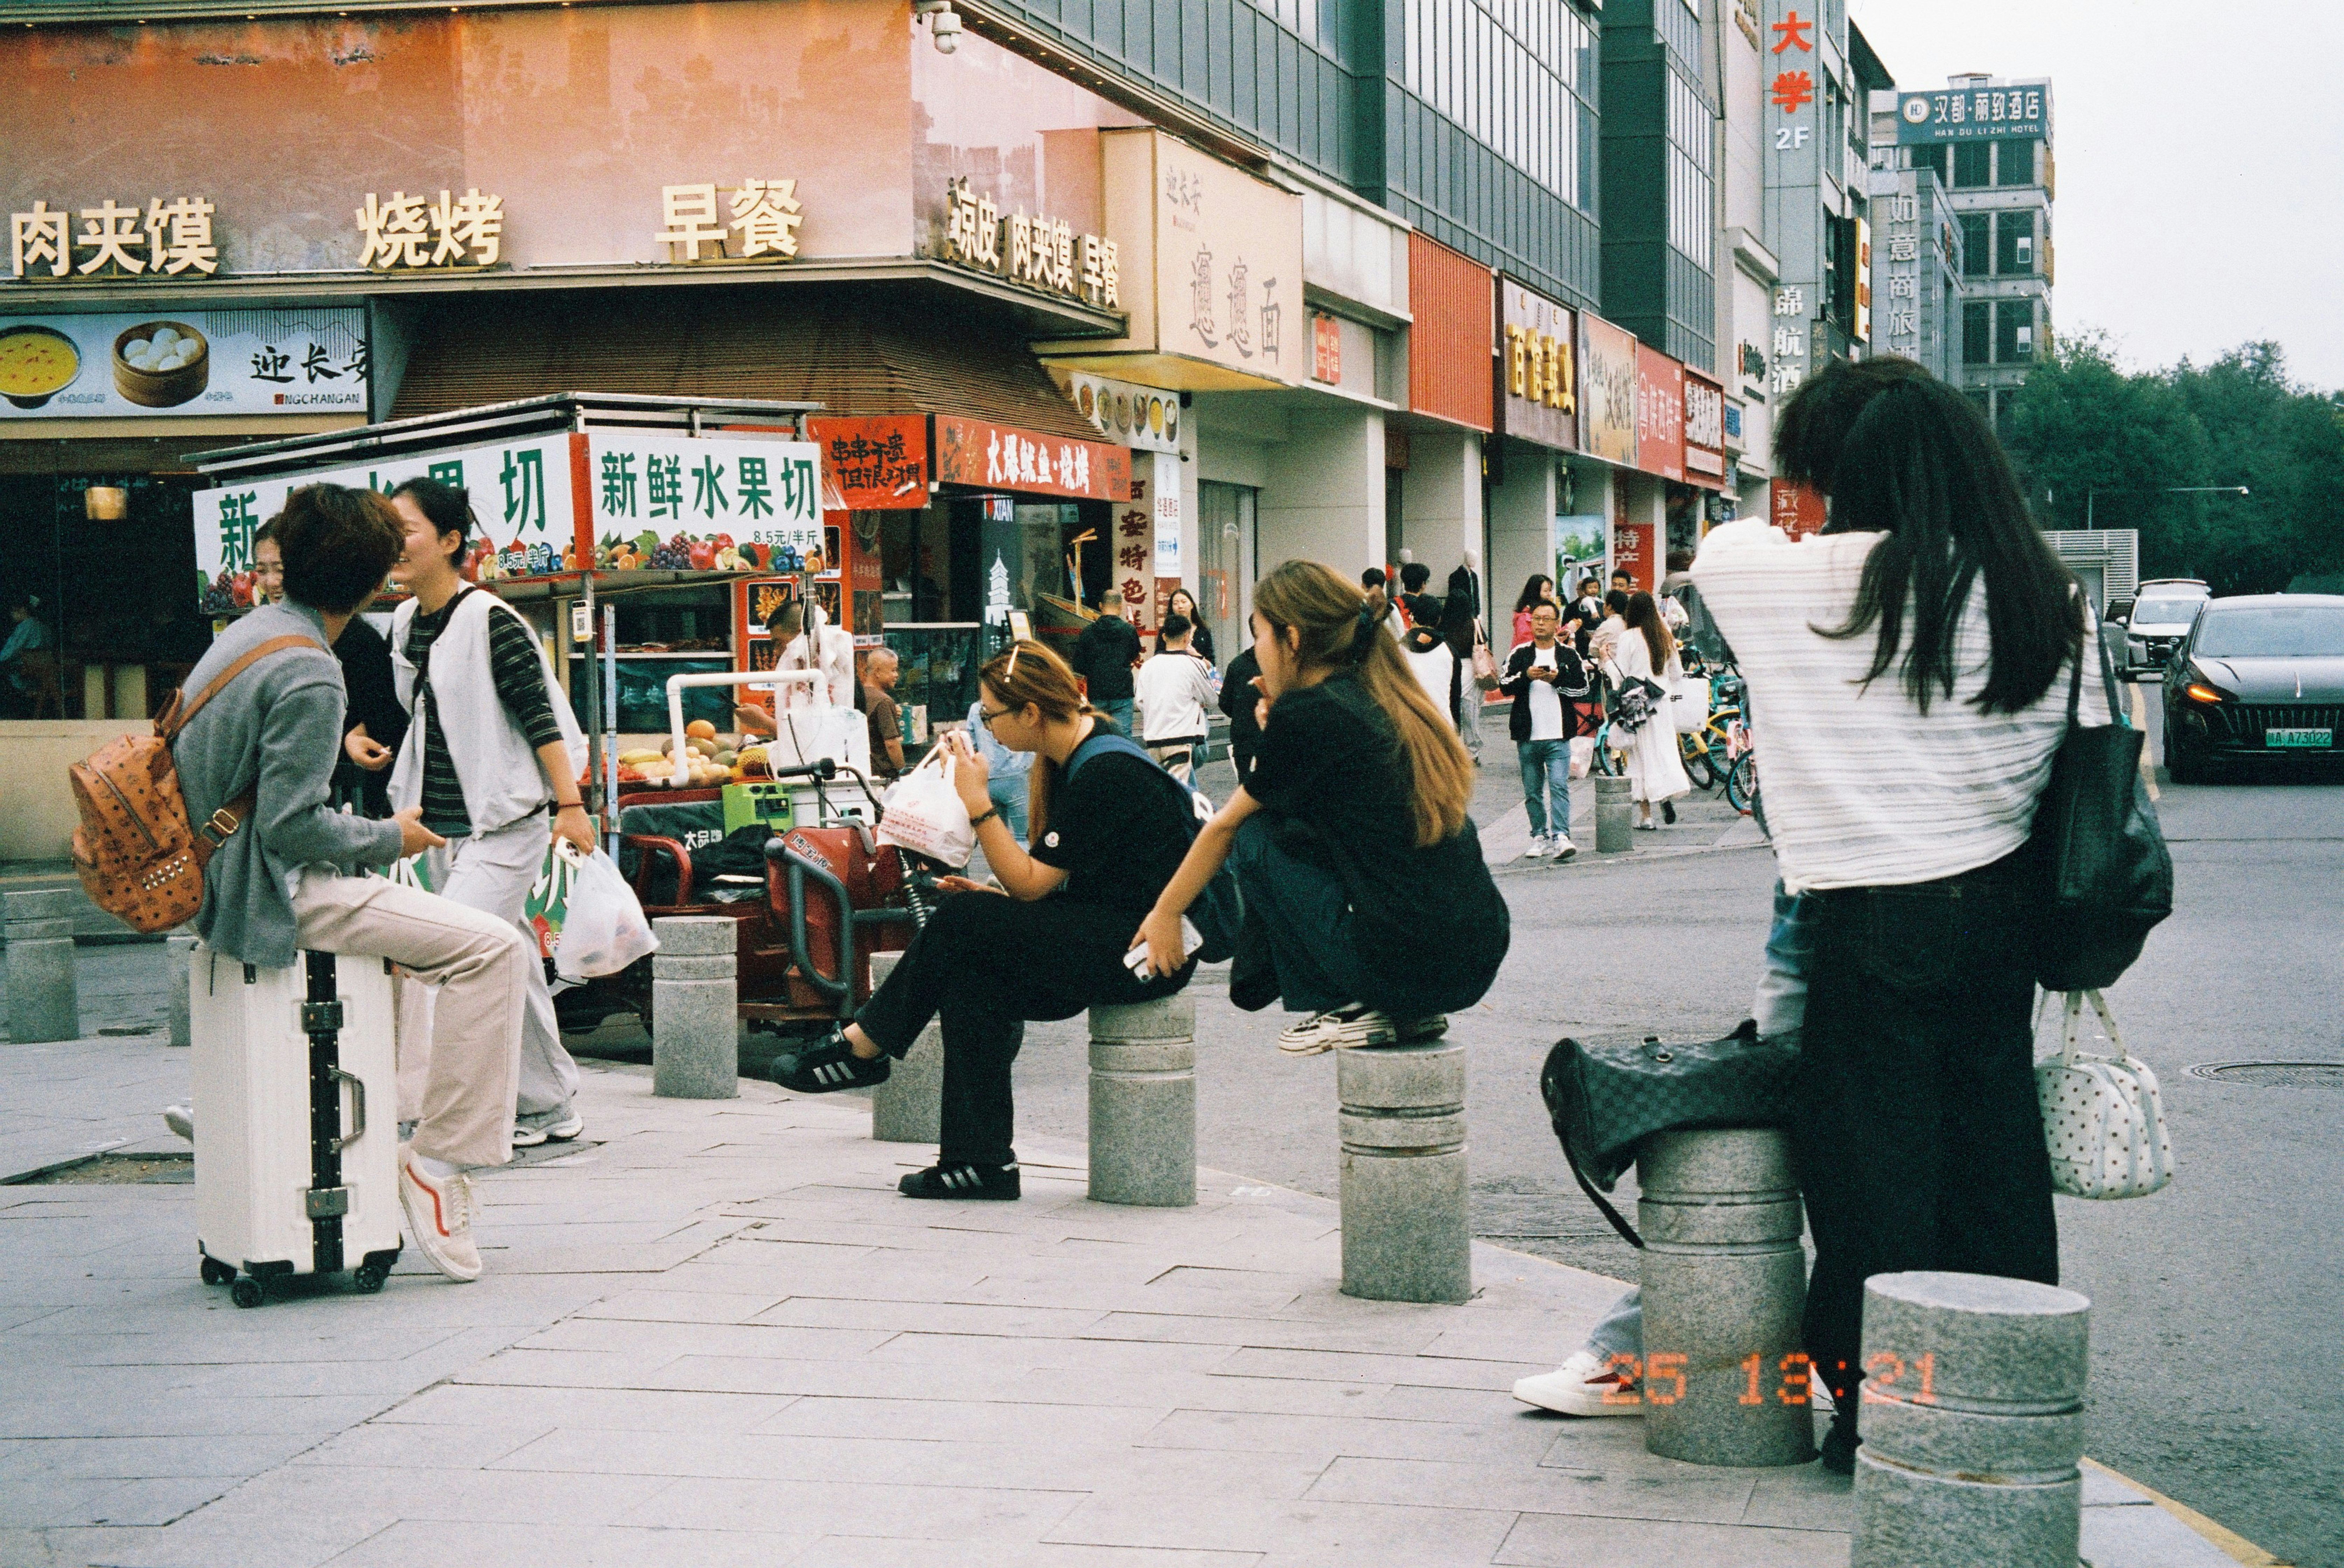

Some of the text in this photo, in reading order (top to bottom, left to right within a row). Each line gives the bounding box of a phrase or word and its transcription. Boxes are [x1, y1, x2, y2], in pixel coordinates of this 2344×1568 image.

[1771, 11, 1813, 114] 大学
[1934, 91, 2039, 124] 汉都·丽致酒店
[1776, 127, 1809, 151] 2F
[1935, 128, 1954, 137] HAN
[1959, 128, 1972, 136] DU
[1990, 126, 2006, 134] ZHI
[2011, 125, 2039, 133] HOTEL
[1166, 166, 1202, 216] 迎长安
[11, 178, 804, 277] 肉夹馍 烧烤 早餐
[948, 182, 1120, 308] 凉皮 肉夹馍 早餐
[250, 339, 367, 384] 迎长安
[1769, 285, 1804, 418] 锦航酒
[600, 451, 815, 521] 新鲜水果切
[753, 529, 818, 546] 8.5元/半斤
[498, 548, 550, 569] 8.5元/半斤
[684, 829, 723, 849] 大品牌
[544, 932, 561, 947] 8.5
